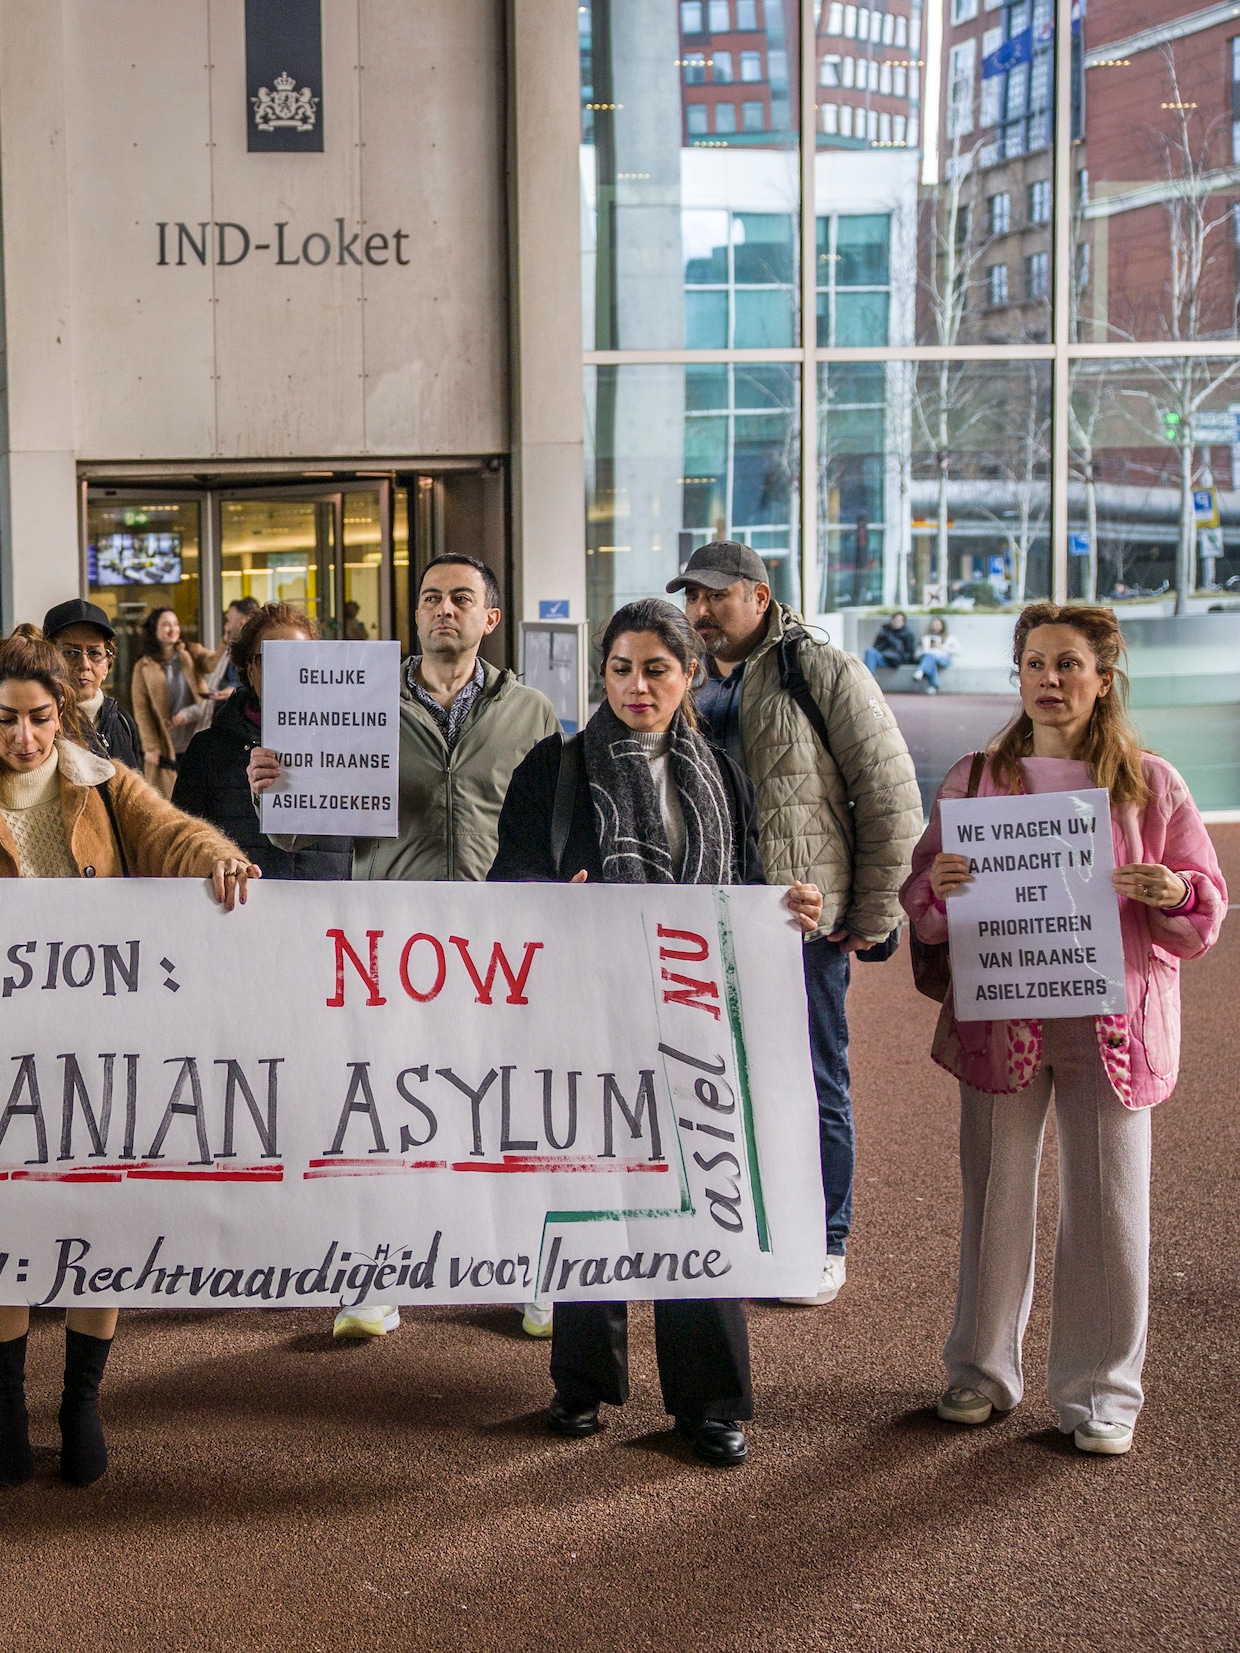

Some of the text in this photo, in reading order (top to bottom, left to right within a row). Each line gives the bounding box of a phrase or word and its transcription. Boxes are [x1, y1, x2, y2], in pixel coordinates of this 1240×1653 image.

[156, 218, 410, 267] IND-Loket
[299, 668, 366, 685] GELIJKE
[277, 711, 387, 727] BEHANDELING
[320, 751, 390, 769] IRAANSE
[272, 793, 391, 811] ASIELZOEKERS
[958, 825, 985, 842] WE
[991, 820, 1061, 839] VRAGEN
[968, 852, 1061, 874] AANDACHT
[1016, 885, 1048, 902] HET
[978, 915, 1092, 937] PRIORITEREN
[326, 928, 545, 1008] NOW
[979, 947, 1096, 968] VAN IRAANSE
[976, 979, 1107, 1001] ASIELZOEKERS
[323, 1062, 667, 1162] ASYLUM
[658, 1042, 745, 1234] asiel
[449, 1253, 530, 1290] voor
